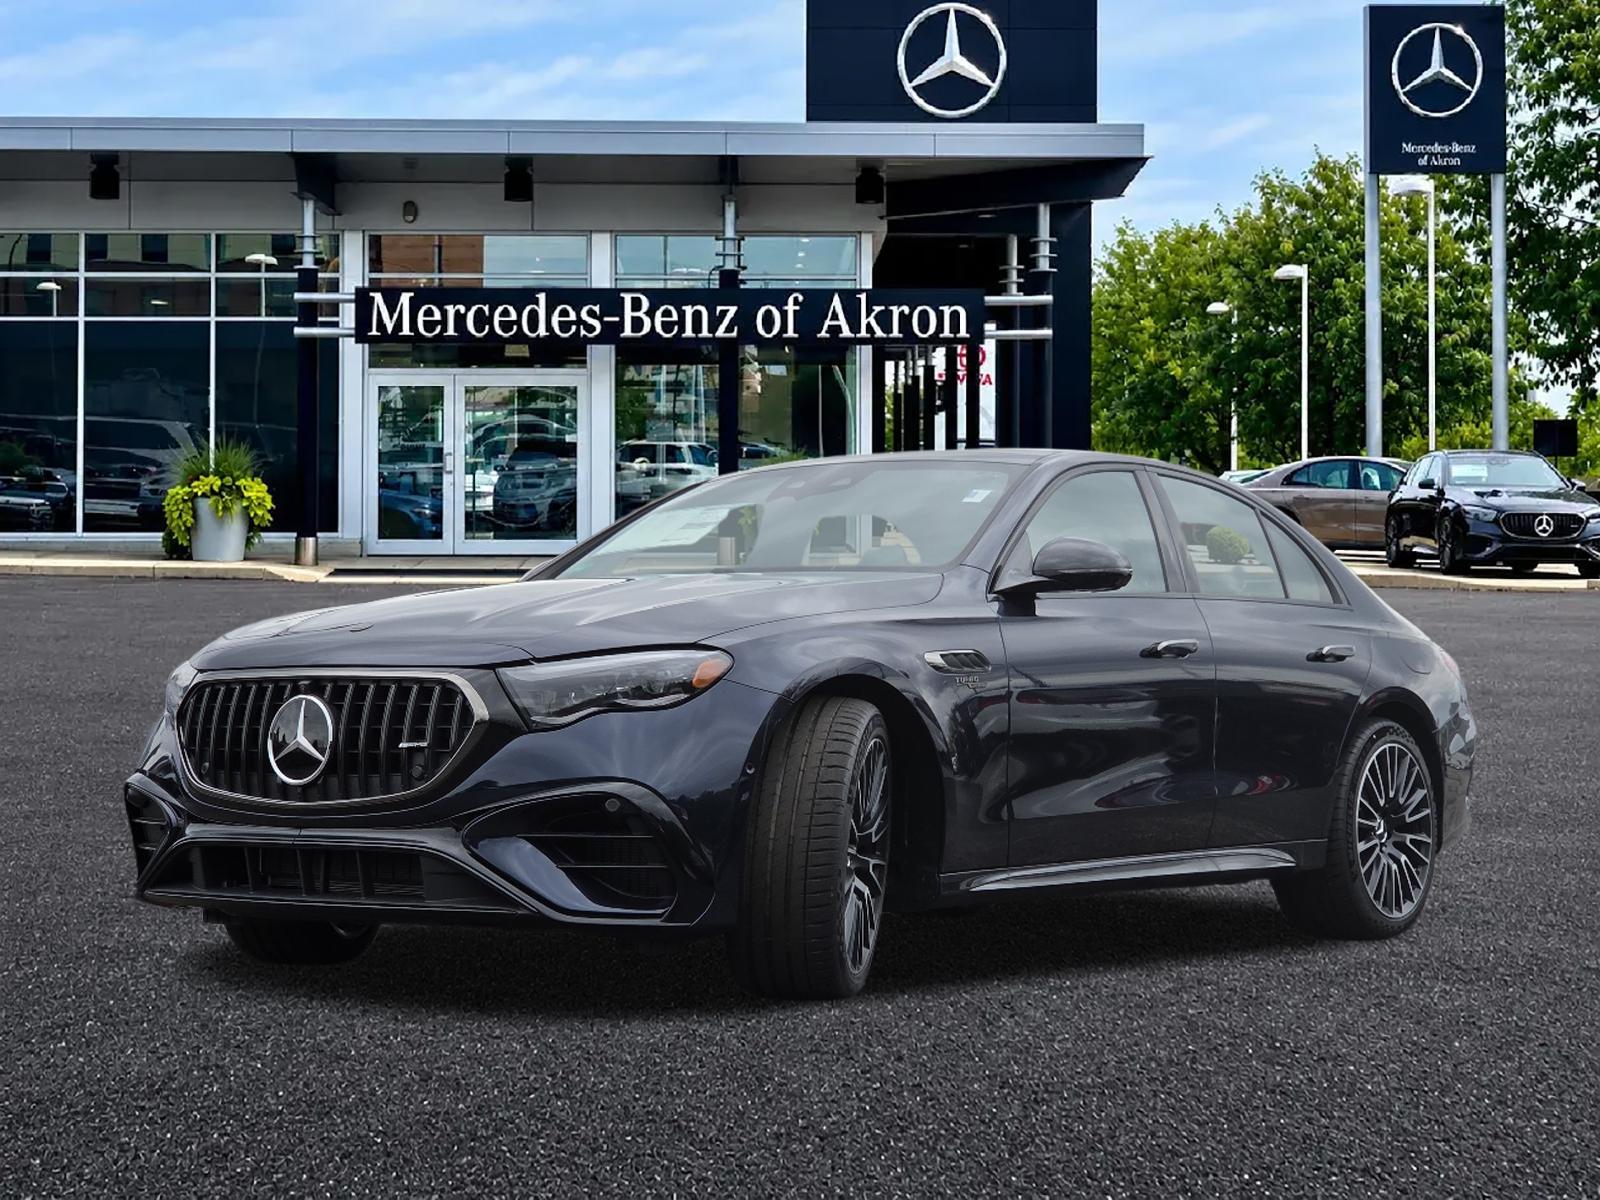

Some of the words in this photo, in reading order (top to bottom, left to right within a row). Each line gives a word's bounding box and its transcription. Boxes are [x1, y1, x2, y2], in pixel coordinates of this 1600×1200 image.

[1401, 141, 1476, 154] Mercedes-Benz
[1417, 154, 1428, 166] of
[1430, 154, 1461, 166] Akron
[367, 291, 738, 338] Mercedes-Benz
[756, 291, 804, 338] of
[816, 291, 970, 338] Akron
